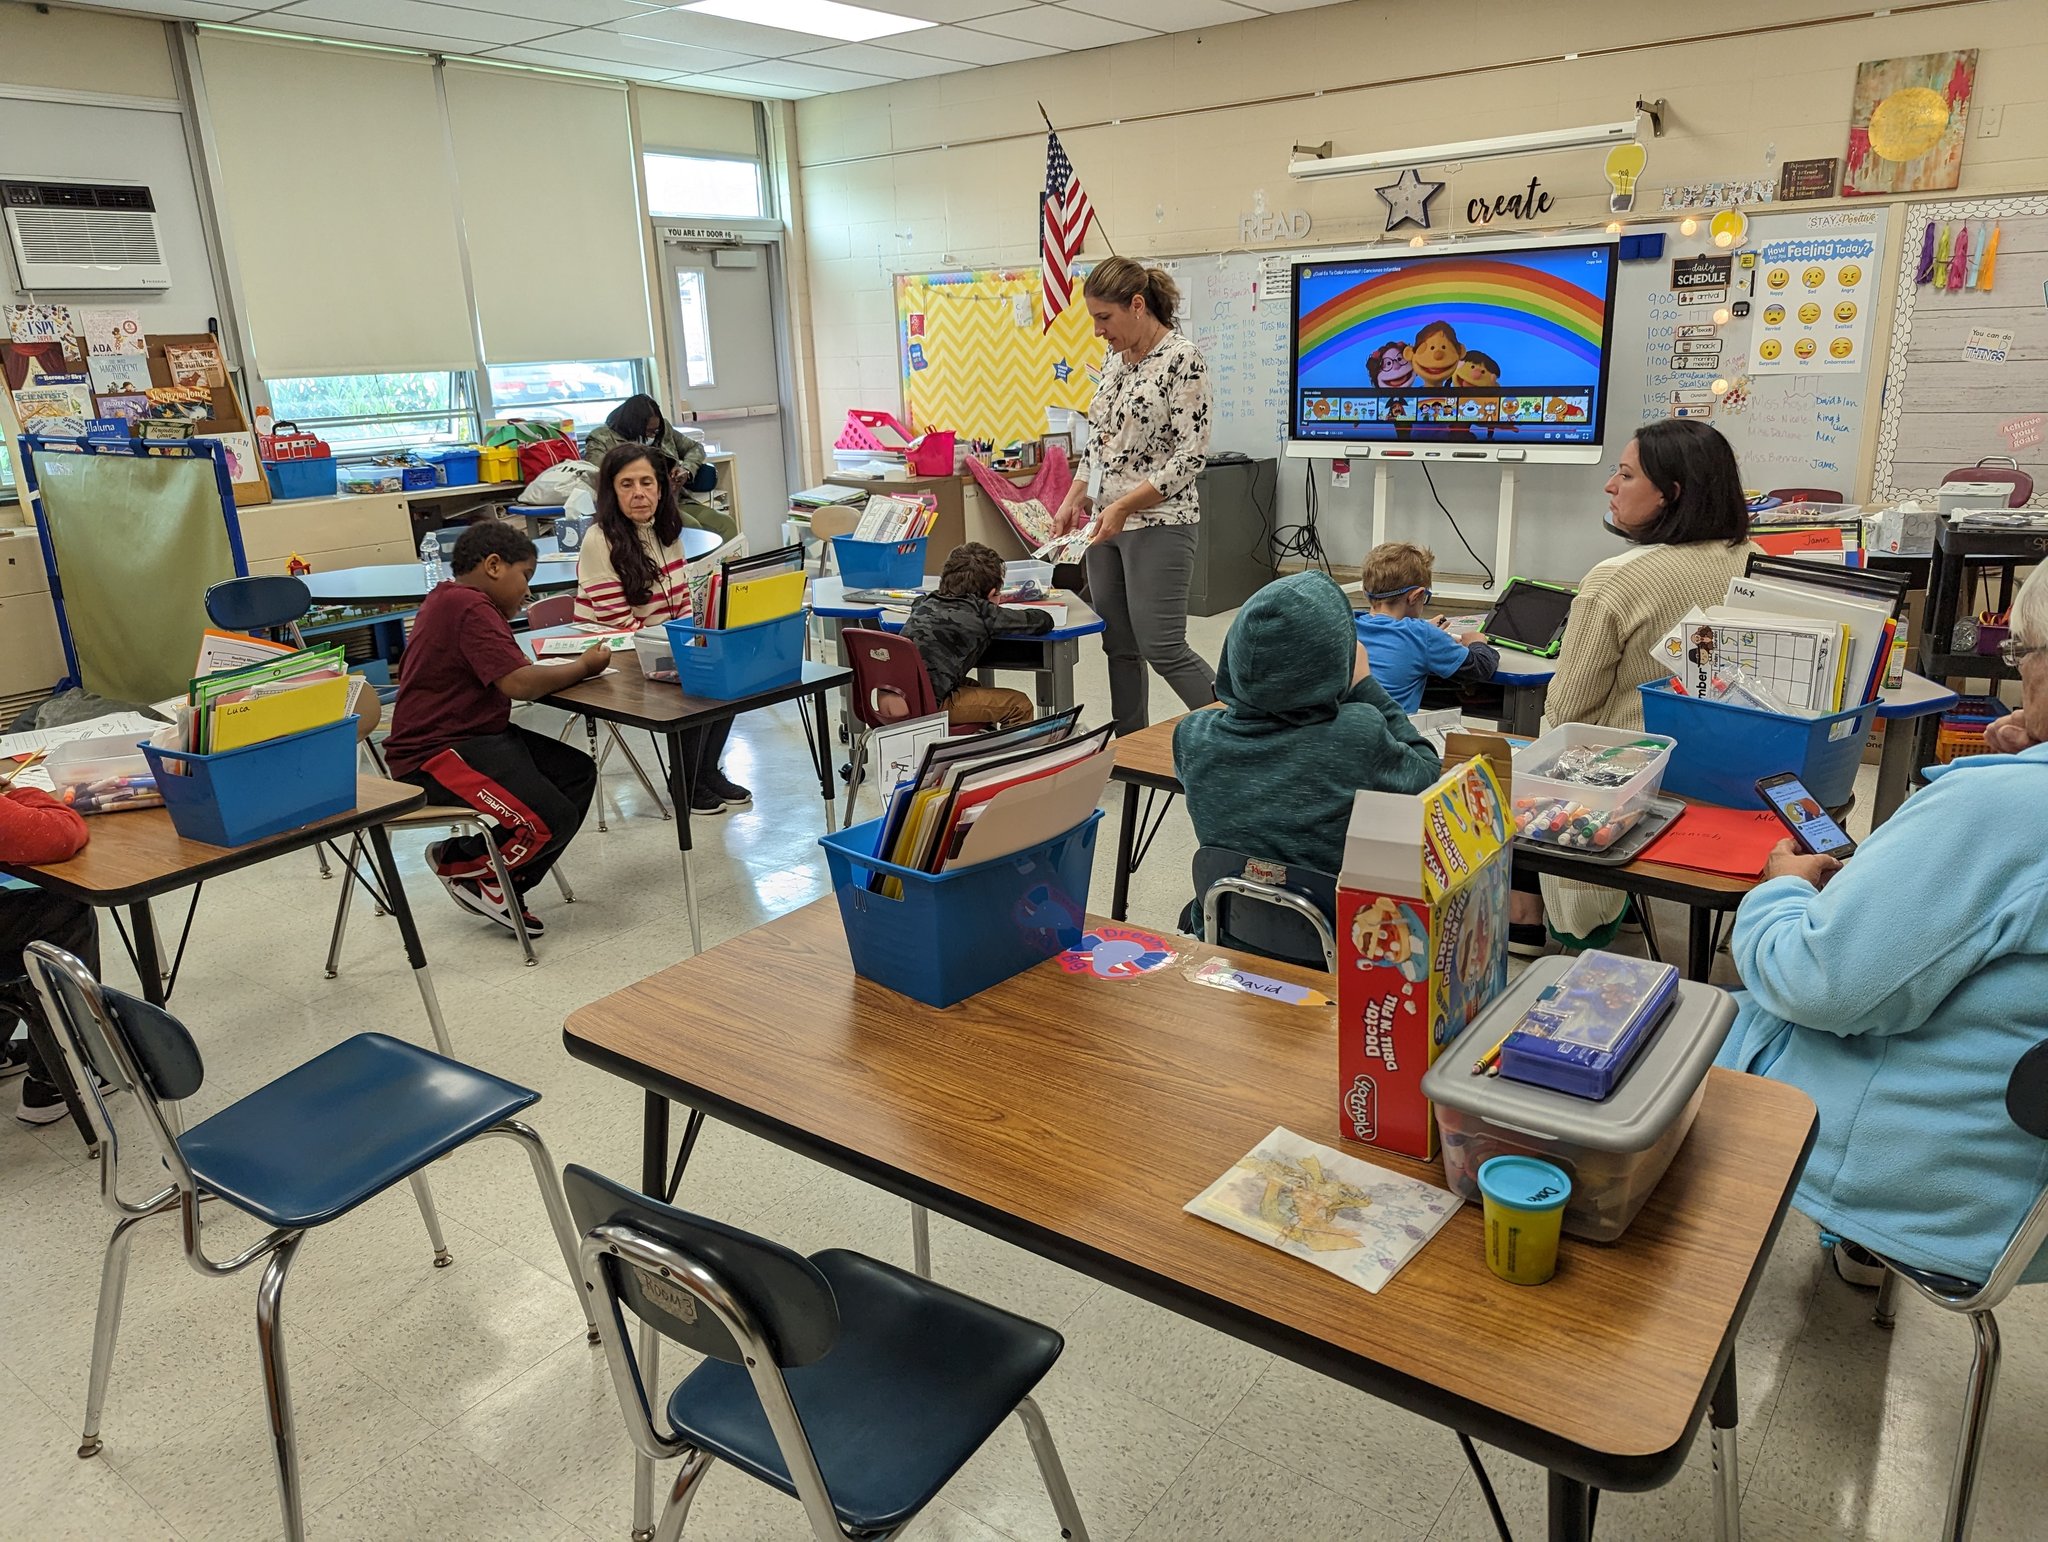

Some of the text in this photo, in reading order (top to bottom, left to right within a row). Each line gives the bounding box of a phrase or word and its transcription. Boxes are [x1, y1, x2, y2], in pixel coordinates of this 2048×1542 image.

[1467, 176, 1555, 224] create
[1659, 178, 1779, 211] LEARN
[1239, 208, 1312, 242] READ
[1811, 213, 1876, 227] STAY Positive
[668, 229, 681, 237] YOU
[683, 229, 695, 237] ARE
[706, 230, 723, 238] DOOR
[1767, 243, 1870, 258] How Feeling Today?
[1692, 263, 1717, 272] daily
[1677, 272, 1726, 285] SCHEDULE
[1697, 292, 1719, 300] arrival
[35, 320, 56, 335] SPY
[1973, 329, 1985, 337] You
[93, 343, 113, 353] ADA
[1966, 346, 2006, 363] THINGS
[15, 391, 69, 401] SCIENTISTS
[2003, 416, 2042, 434] Achieve
[1816, 431, 1836, 443] Max
[2012, 427, 2036, 440] your
[2013, 433, 2040, 448] goals
[1801, 534, 1830, 546] James
[1734, 586, 1755, 598] Max
[1696, 668, 1707, 698] mber
[226, 706, 250, 716] Luca
[1755, 813, 1777, 822] Ma
[1430, 812, 1459, 872] Doctor
[1104, 928, 1165, 949] Dream
[1434, 893, 1457, 973] Doctor
[1061, 954, 1087, 972] Big
[1442, 942, 1455, 988] DRILL
[1231, 973, 1283, 994] David
[1382, 993, 1399, 1018] FILL
[1362, 998, 1381, 1058] Doctor
[1379, 1034, 1399, 1072] DRILL
[1350, 1079, 1373, 1139] Play-Doh
[643, 1273, 694, 1317] ROOM 3
